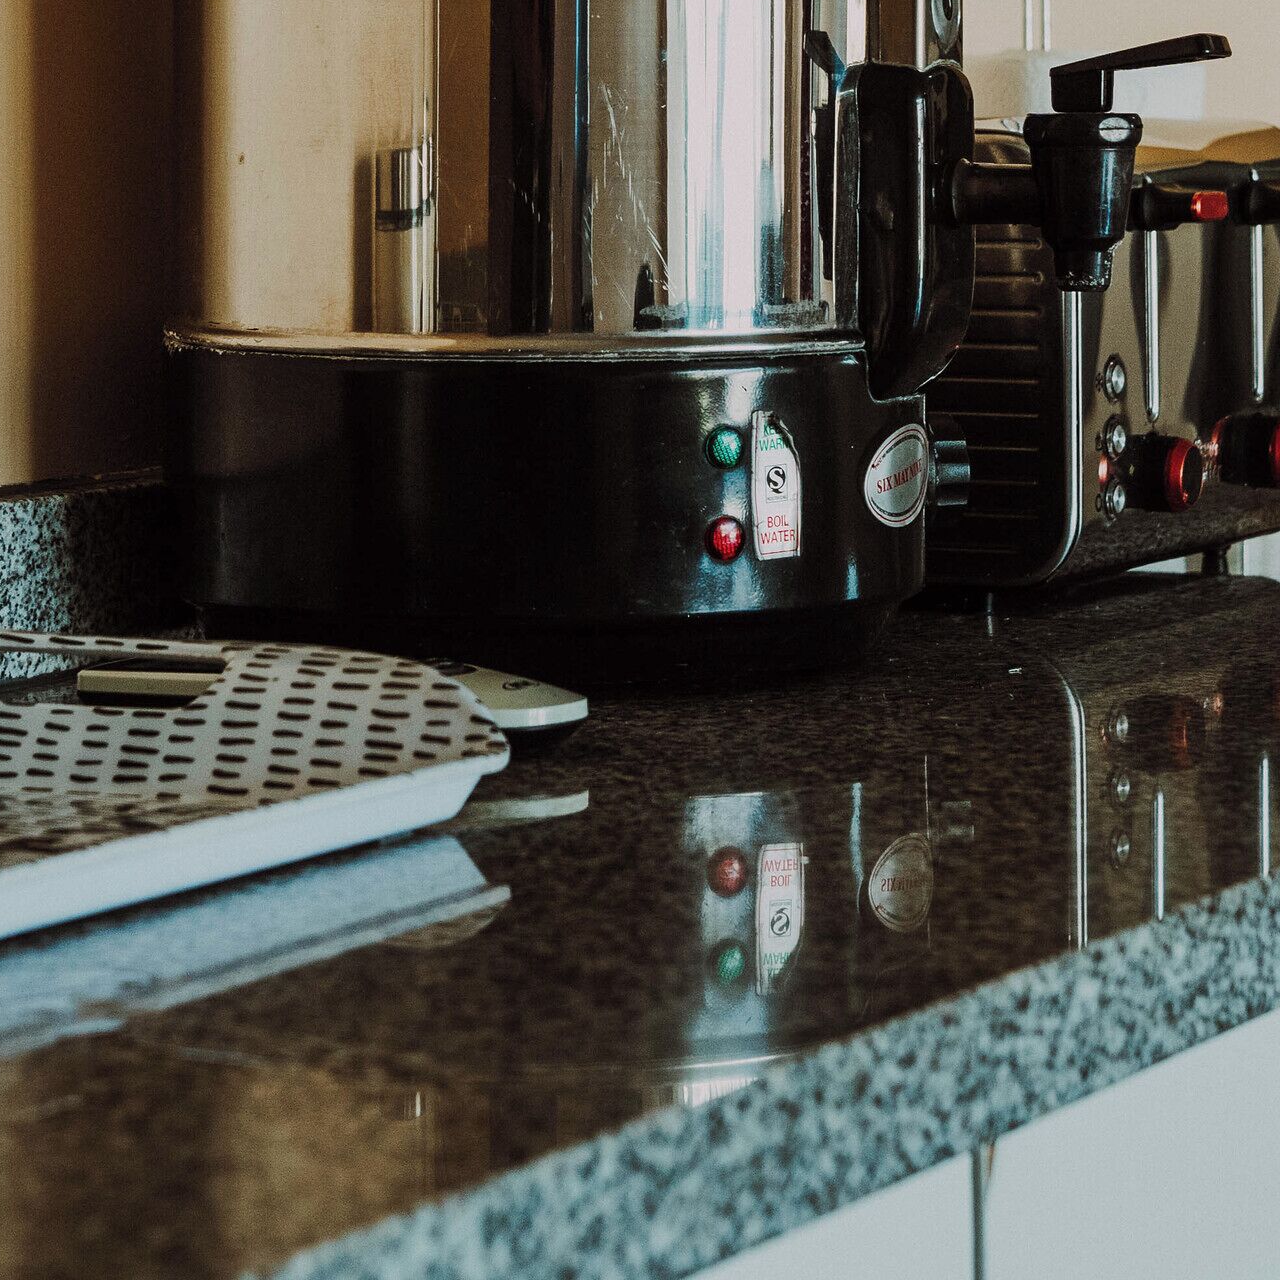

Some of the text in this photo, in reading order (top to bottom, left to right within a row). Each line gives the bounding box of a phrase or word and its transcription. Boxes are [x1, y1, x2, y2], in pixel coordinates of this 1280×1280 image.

[759, 437, 785, 451] WAR
[767, 515, 789, 528] BOIL
[761, 529, 796, 545] WATER
